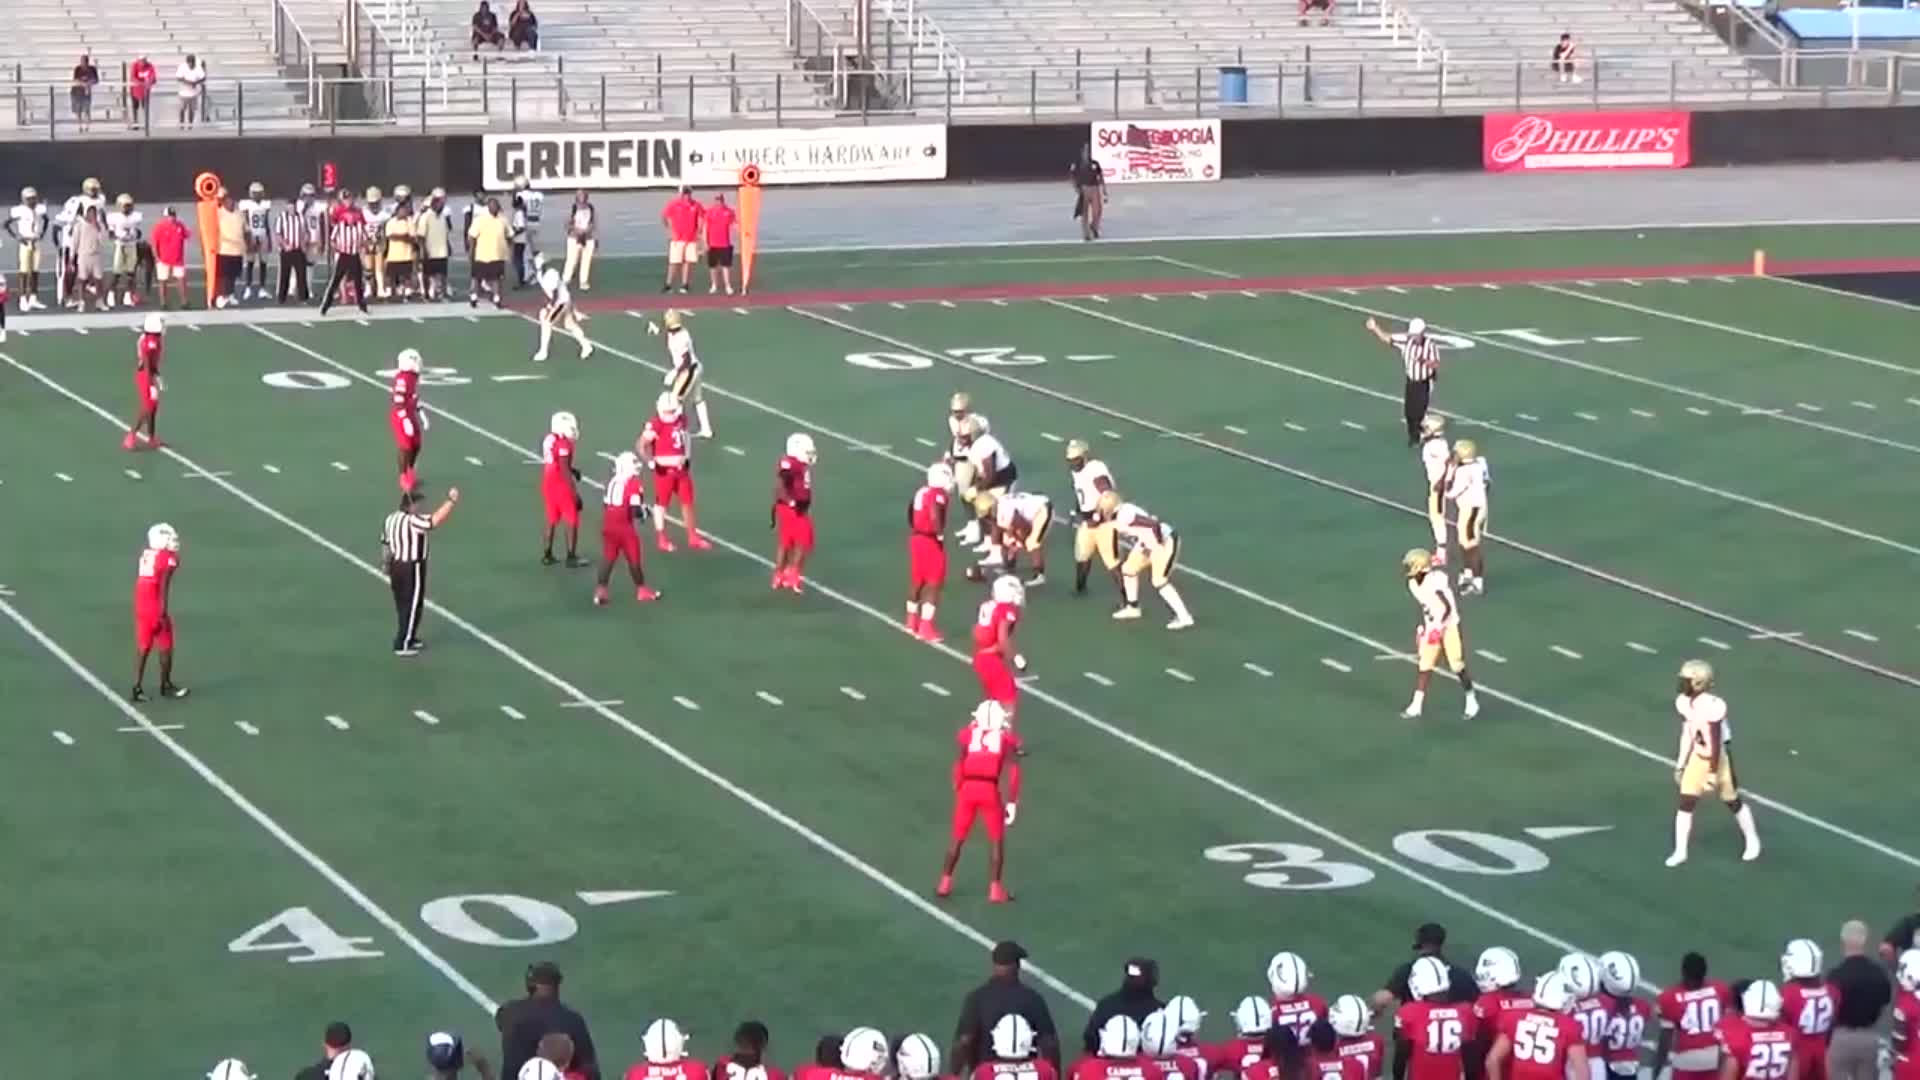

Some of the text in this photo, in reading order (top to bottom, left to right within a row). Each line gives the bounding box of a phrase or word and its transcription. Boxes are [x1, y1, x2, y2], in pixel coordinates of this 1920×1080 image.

[1491, 116, 1680, 162] PHILLIP'S
[496, 138, 682, 182] GRIFFIN
[1203, 809, 1550, 890] 30
[228, 893, 579, 963] 40
[1608, 1014, 1645, 1051] 38
[1680, 998, 1721, 1035] 40
[1798, 996, 1834, 1035] 42
[1425, 1019, 1463, 1054] 16
[1513, 1019, 1560, 1065] 55
[1745, 1042, 1792, 1079] 25
